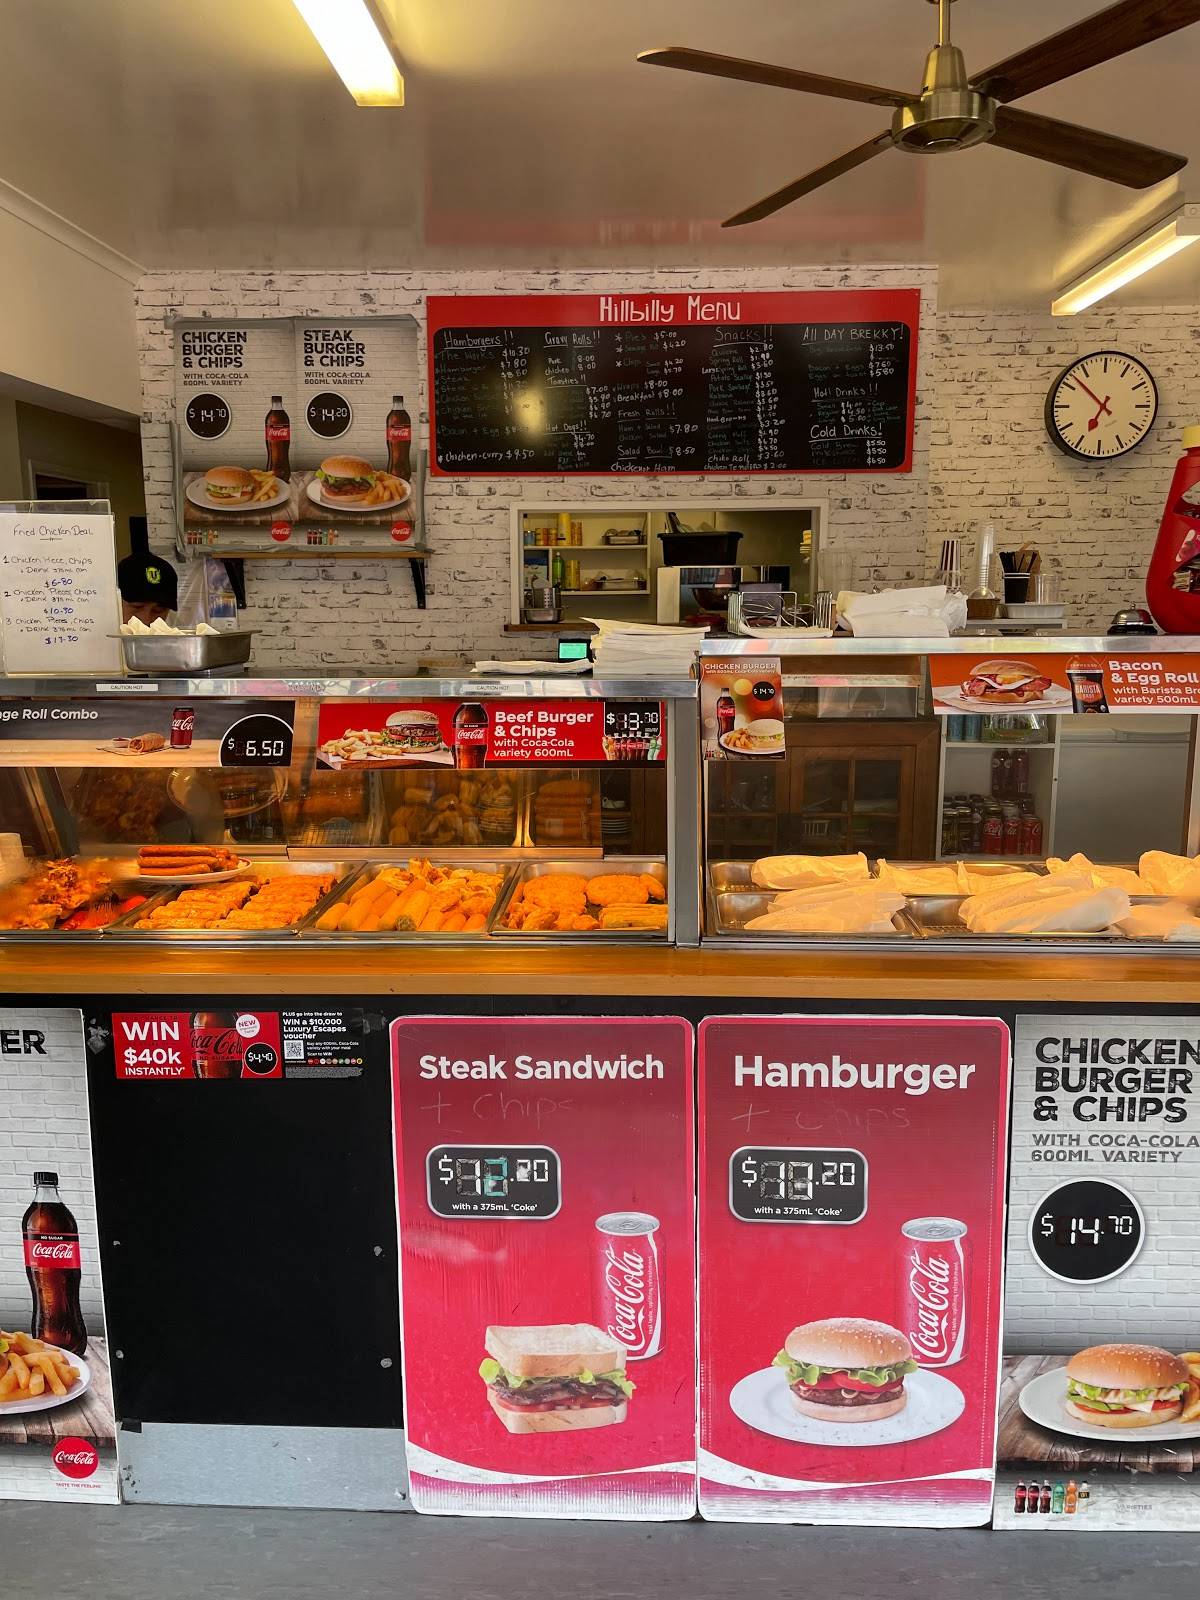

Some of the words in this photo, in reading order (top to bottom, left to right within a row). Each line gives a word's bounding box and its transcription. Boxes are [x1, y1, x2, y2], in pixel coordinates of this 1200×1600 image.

[600, 297, 674, 322] Hillbilly
[687, 295, 741, 321] Menu
[182, 331, 247, 343] CHICKEN
[303, 330, 353, 342] STEAK
[824, 328, 844, 341] DAY
[183, 344, 244, 356] BURGER
[304, 343, 366, 355] BURGER
[183, 358, 192, 368] &
[198, 357, 243, 369] CHIPS
[304, 356, 314, 367] &
[319, 355, 365, 368] CHIPS
[811, 425, 837, 439] Cold
[13, 523, 35, 537] Fried
[38, 525, 71, 536] Chicken
[1108, 660, 1163, 671] Bacon
[1111, 673, 1124, 684] &
[1126, 673, 1160, 685] Egg
[1164, 672, 1199, 683] Roll
[1075, 684, 1101, 694] BARISTA
[1112, 686, 1138, 694] with
[1141, 686, 1182, 694] Barista
[1114, 695, 1154, 704] variety
[1157, 695, 1198, 704] 500mL
[22, 709, 48, 720] Roll
[50, 709, 99, 720] Combo
[495, 711, 533, 724] Beef
[537, 711, 594, 726] Burger
[457, 729, 484, 740] Coca-Cola
[494, 725, 508, 737] &
[510, 724, 557, 739] Chips
[494, 739, 517, 747] with
[521, 739, 574, 748] Coca-Cola
[494, 748, 531, 759] variety
[534, 748, 574, 758] 600mL
[238, 1020, 256, 1028] NEW
[309, 1018, 342, 1026] $10,000
[121, 1021, 180, 1041] WIN
[283, 1025, 311, 1034] Luxury
[312, 1025, 347, 1034] Escapes
[123, 1046, 183, 1067] $40k
[1035, 1037, 1200, 1065] CHICKEN
[419, 1055, 507, 1080] Steak
[514, 1054, 664, 1080] Sandwich
[735, 1055, 976, 1096] Hamburger
[1035, 1067, 1193, 1093] BURGER
[420, 1091, 451, 1124] +
[1033, 1096, 1058, 1122] &
[1073, 1096, 1187, 1123] CHIPS
[731, 1103, 770, 1133] +
[1032, 1134, 1081, 1147] WITH
[1088, 1134, 1200, 1148] COCA-COLA
[1031, 1150, 1095, 1162] 600ML
[1102, 1150, 1183, 1163] VARIETY
[452, 1203, 471, 1211] with
[480, 1203, 510, 1211] 375mL
[754, 1206, 774, 1214] with
[783, 1207, 813, 1215] 375mL
[32, 1242, 73, 1260] Coca-Cola
[56, 1451, 95, 1465] Coca-Cola
